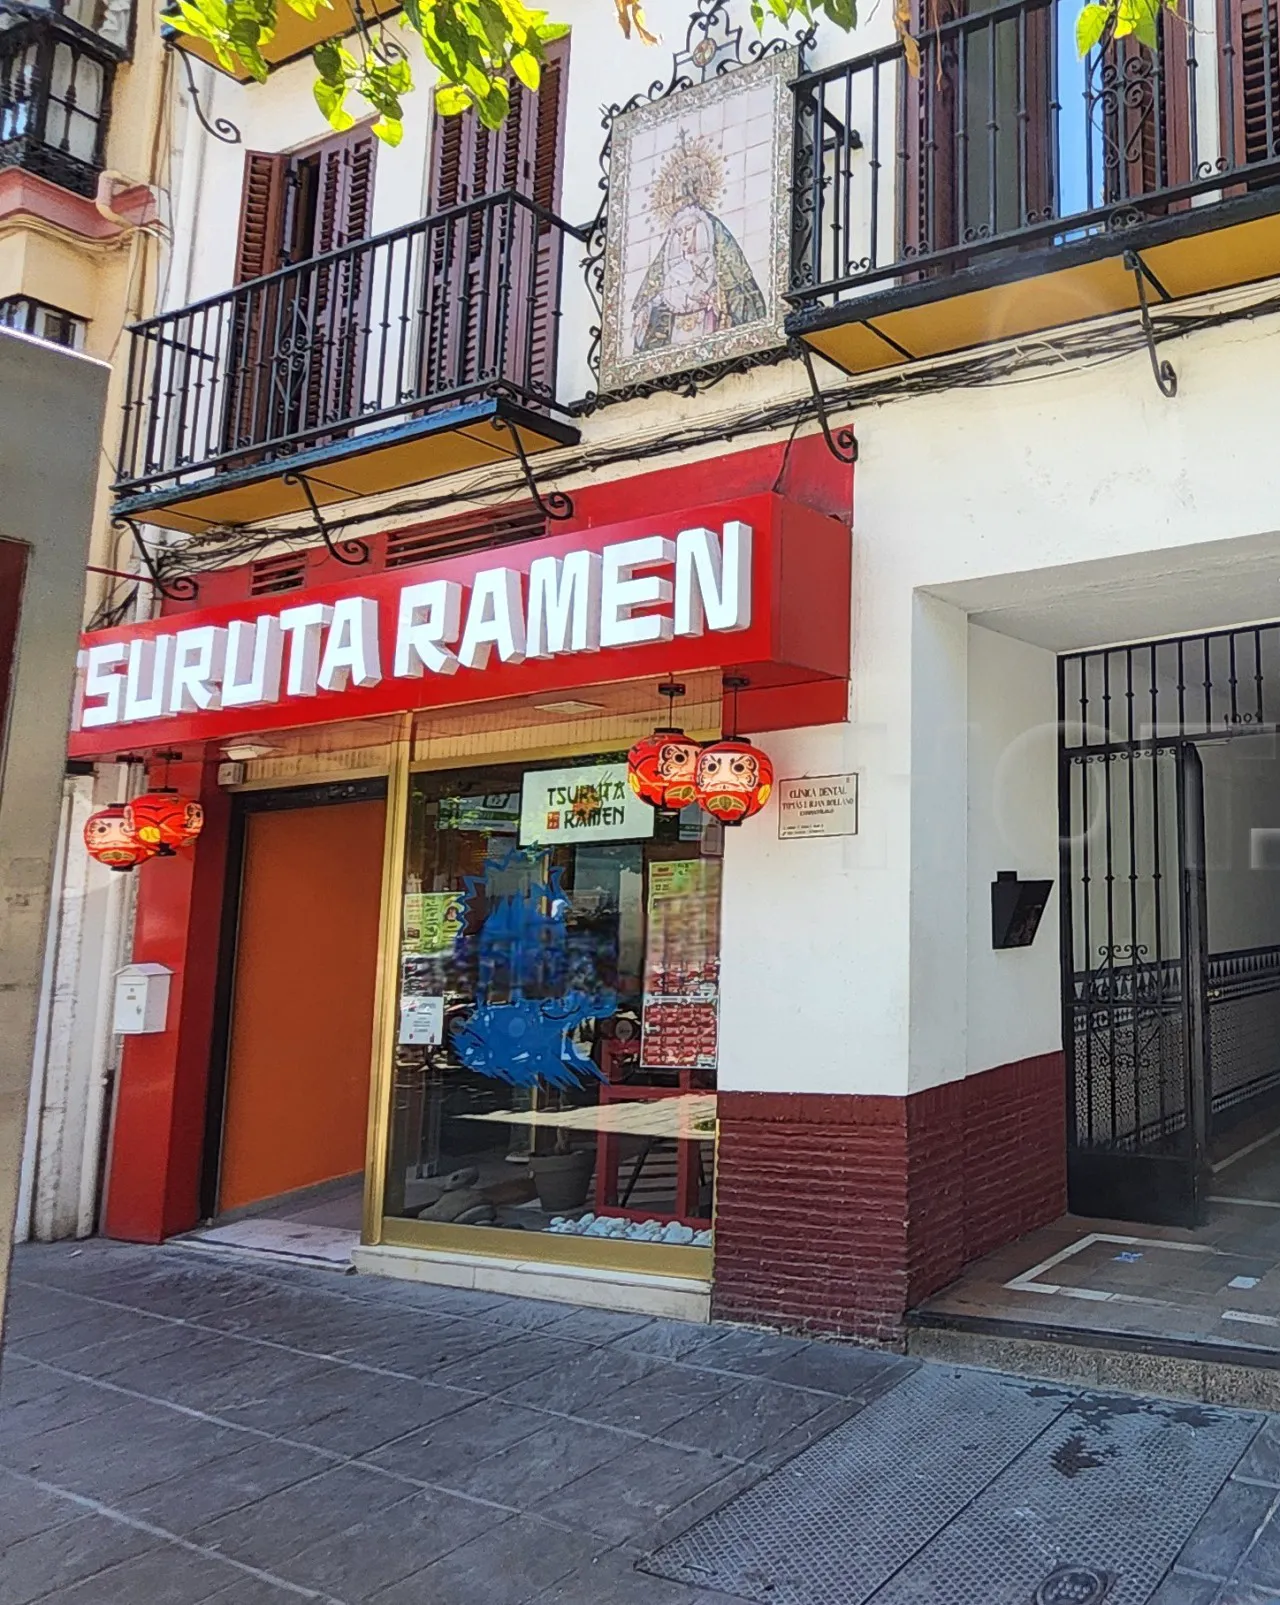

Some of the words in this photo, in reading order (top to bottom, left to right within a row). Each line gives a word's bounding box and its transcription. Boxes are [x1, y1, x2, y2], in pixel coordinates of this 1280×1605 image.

[72, 597, 382, 732] SURUTA
[394, 520, 752, 679] RAMEN
[547, 780, 626, 806] TSURUTA
[563, 806, 625, 829] RAMEN
